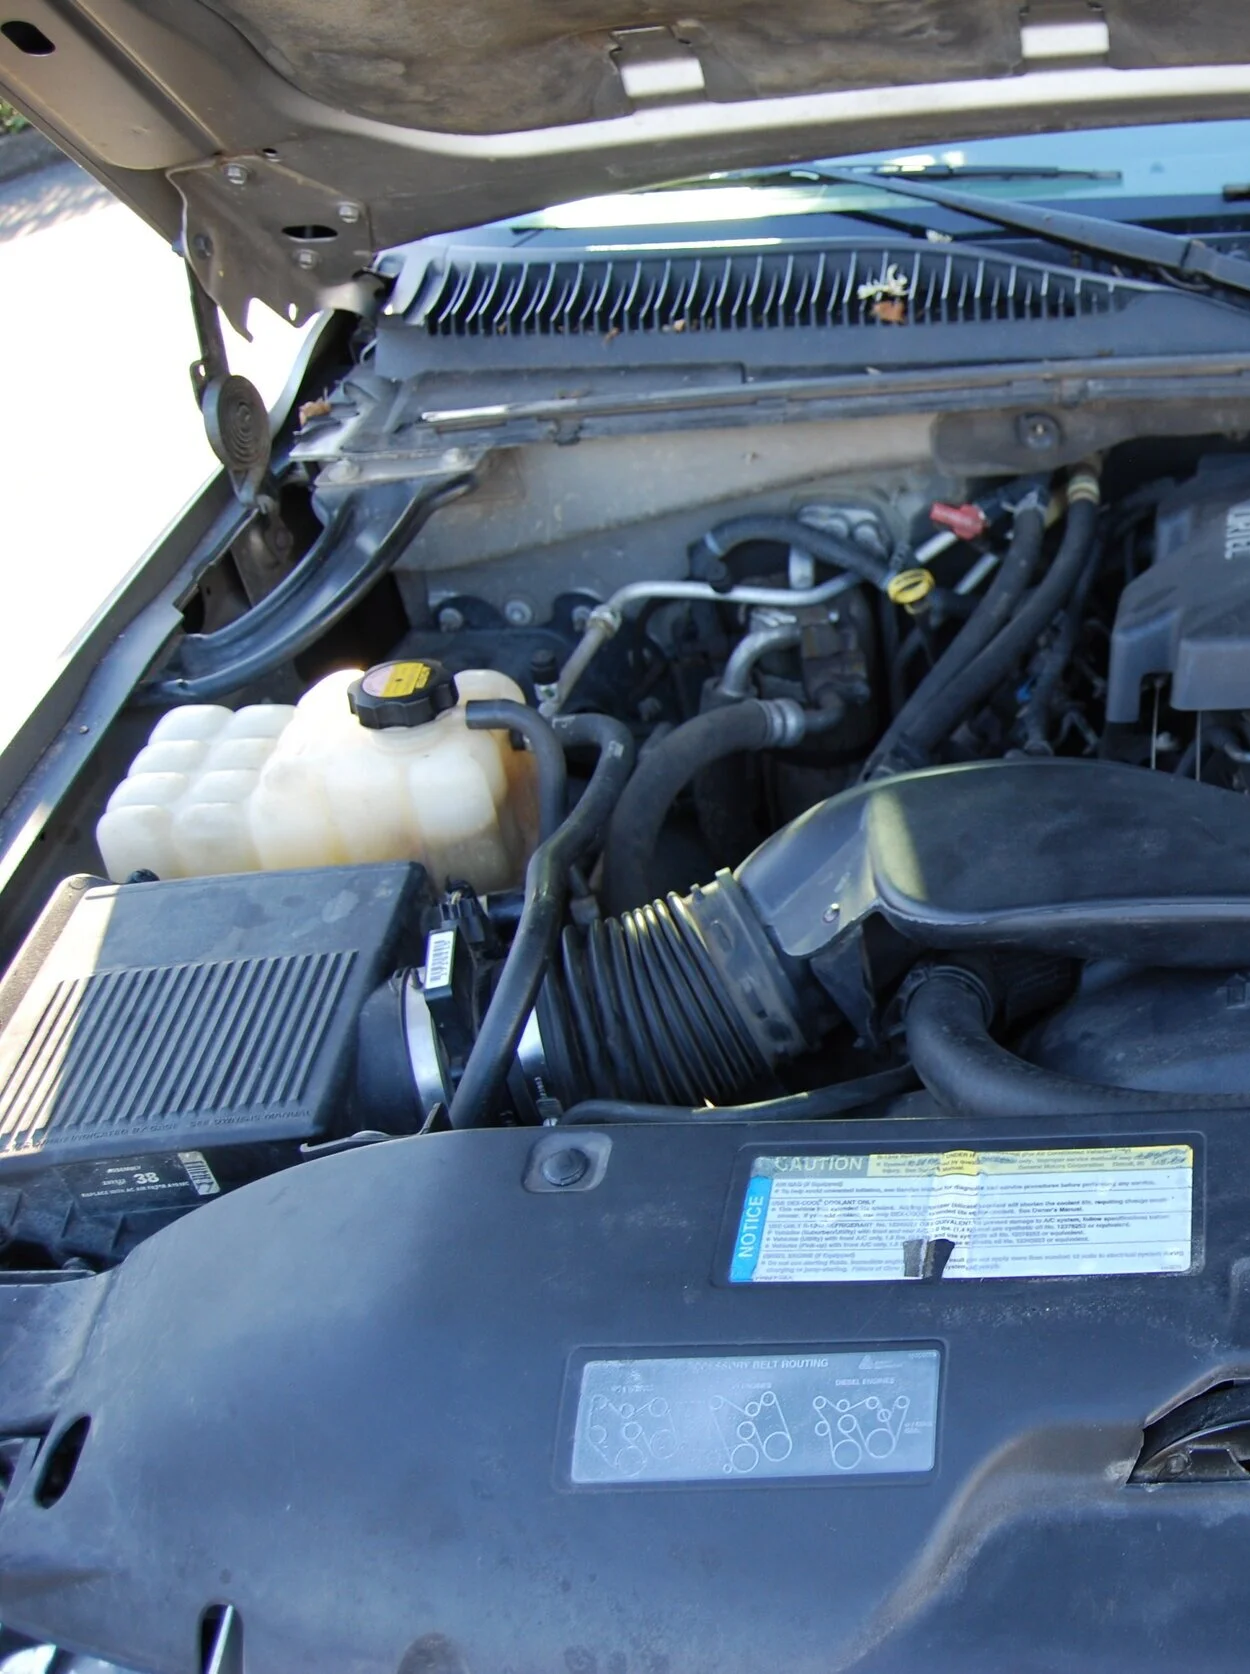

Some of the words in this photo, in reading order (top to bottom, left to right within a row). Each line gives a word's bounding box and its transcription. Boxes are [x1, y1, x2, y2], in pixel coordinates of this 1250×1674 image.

[775, 1156, 862, 1172] CAUTION
[133, 1172, 160, 1184] 38
[738, 1195, 764, 1258] NOTICE
[751, 1360, 778, 1369] BELT
[780, 1358, 829, 1369] ROUTING
[835, 1378, 860, 1386] DIESEL
[862, 1376, 895, 1386] ENGINES
